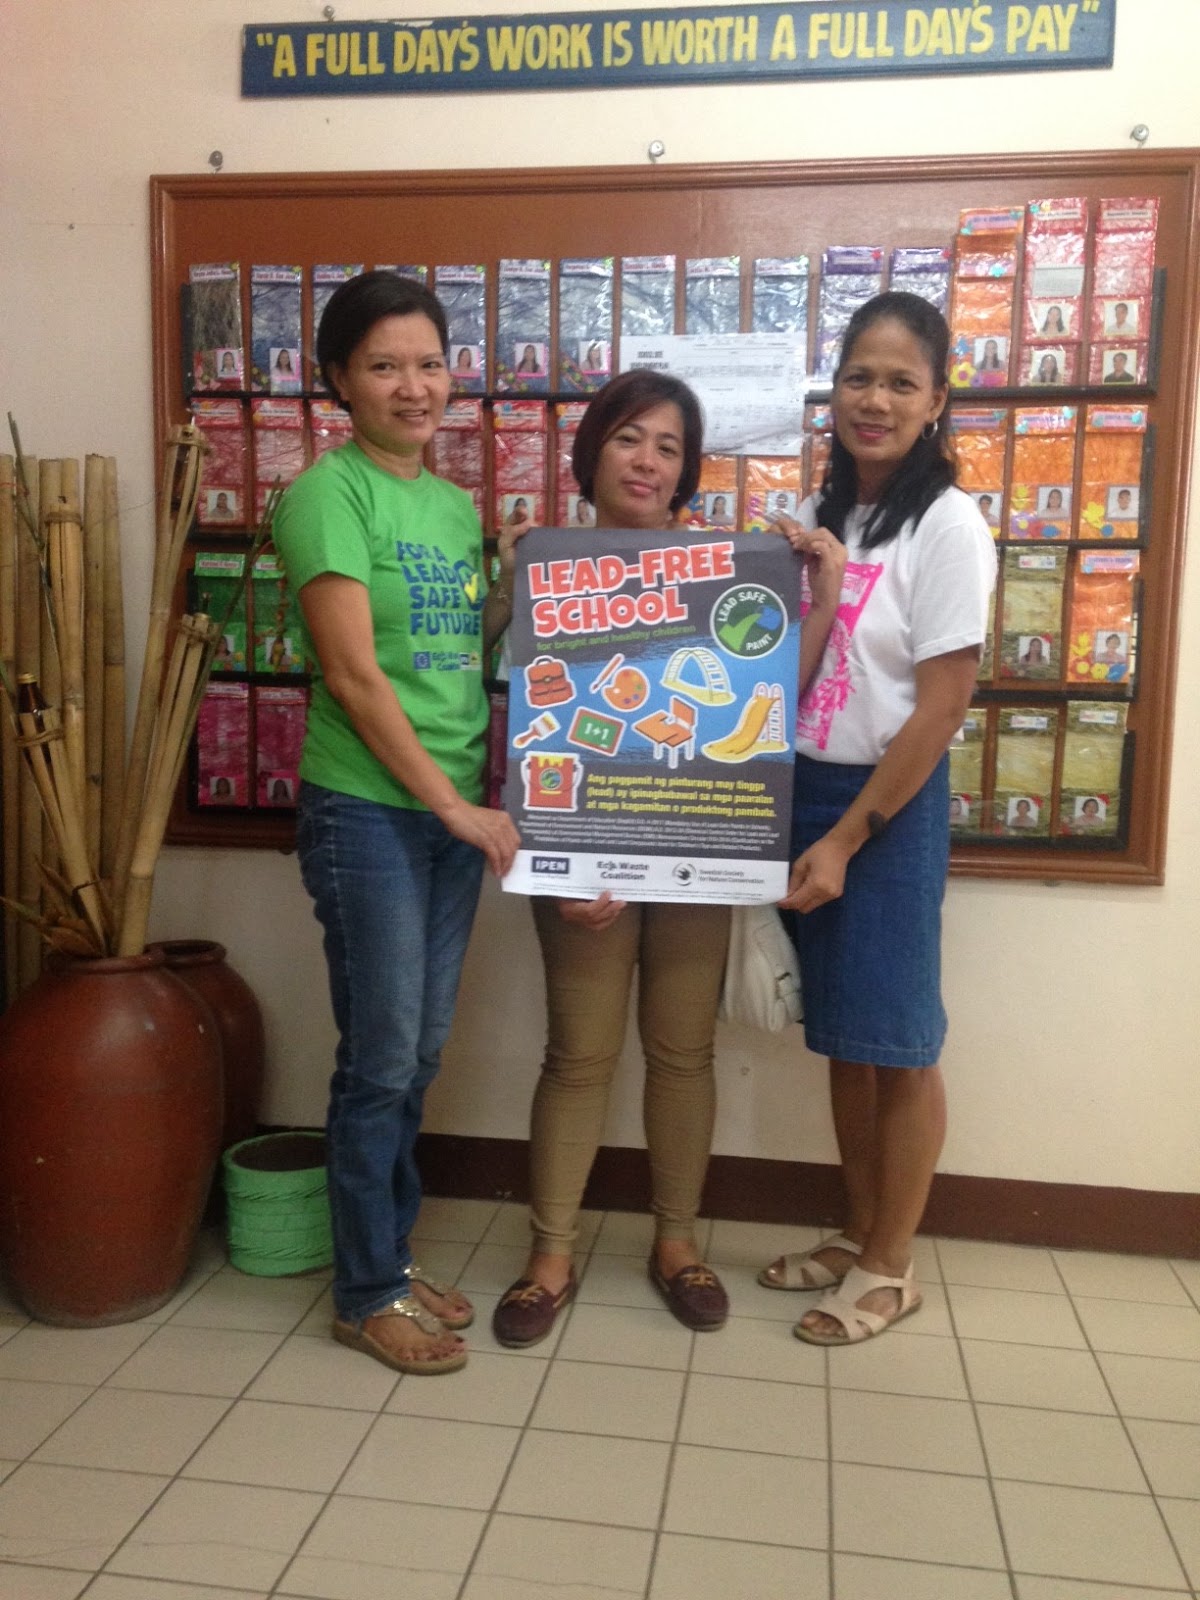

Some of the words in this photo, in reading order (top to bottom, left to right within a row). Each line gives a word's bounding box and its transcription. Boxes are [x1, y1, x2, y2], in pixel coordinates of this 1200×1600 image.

[306, 31, 386, 77] FULL
[393, 21, 480, 75] DAY'S
[486, 24, 593, 72] WORK
[603, 21, 633, 68] IS
[641, 15, 759, 66] WORTH
[769, 13, 797, 61] A
[808, 10, 895, 60] FULL
[402, 563, 457, 584] LEAD
[528, 541, 736, 600] LEAD-FREE
[410, 585, 461, 610] SAFE
[717, 596, 738, 622] LEAD
[737, 590, 768, 604] SAFE
[410, 612, 480, 636] FUTURE
[532, 586, 688, 638] SCHOOL
[588, 635, 610, 645] and
[652, 625, 697, 637] children
[745, 633, 773, 651] PAINT
[535, 860, 567, 872] IPEN
[600, 871, 646, 880] Coalition
